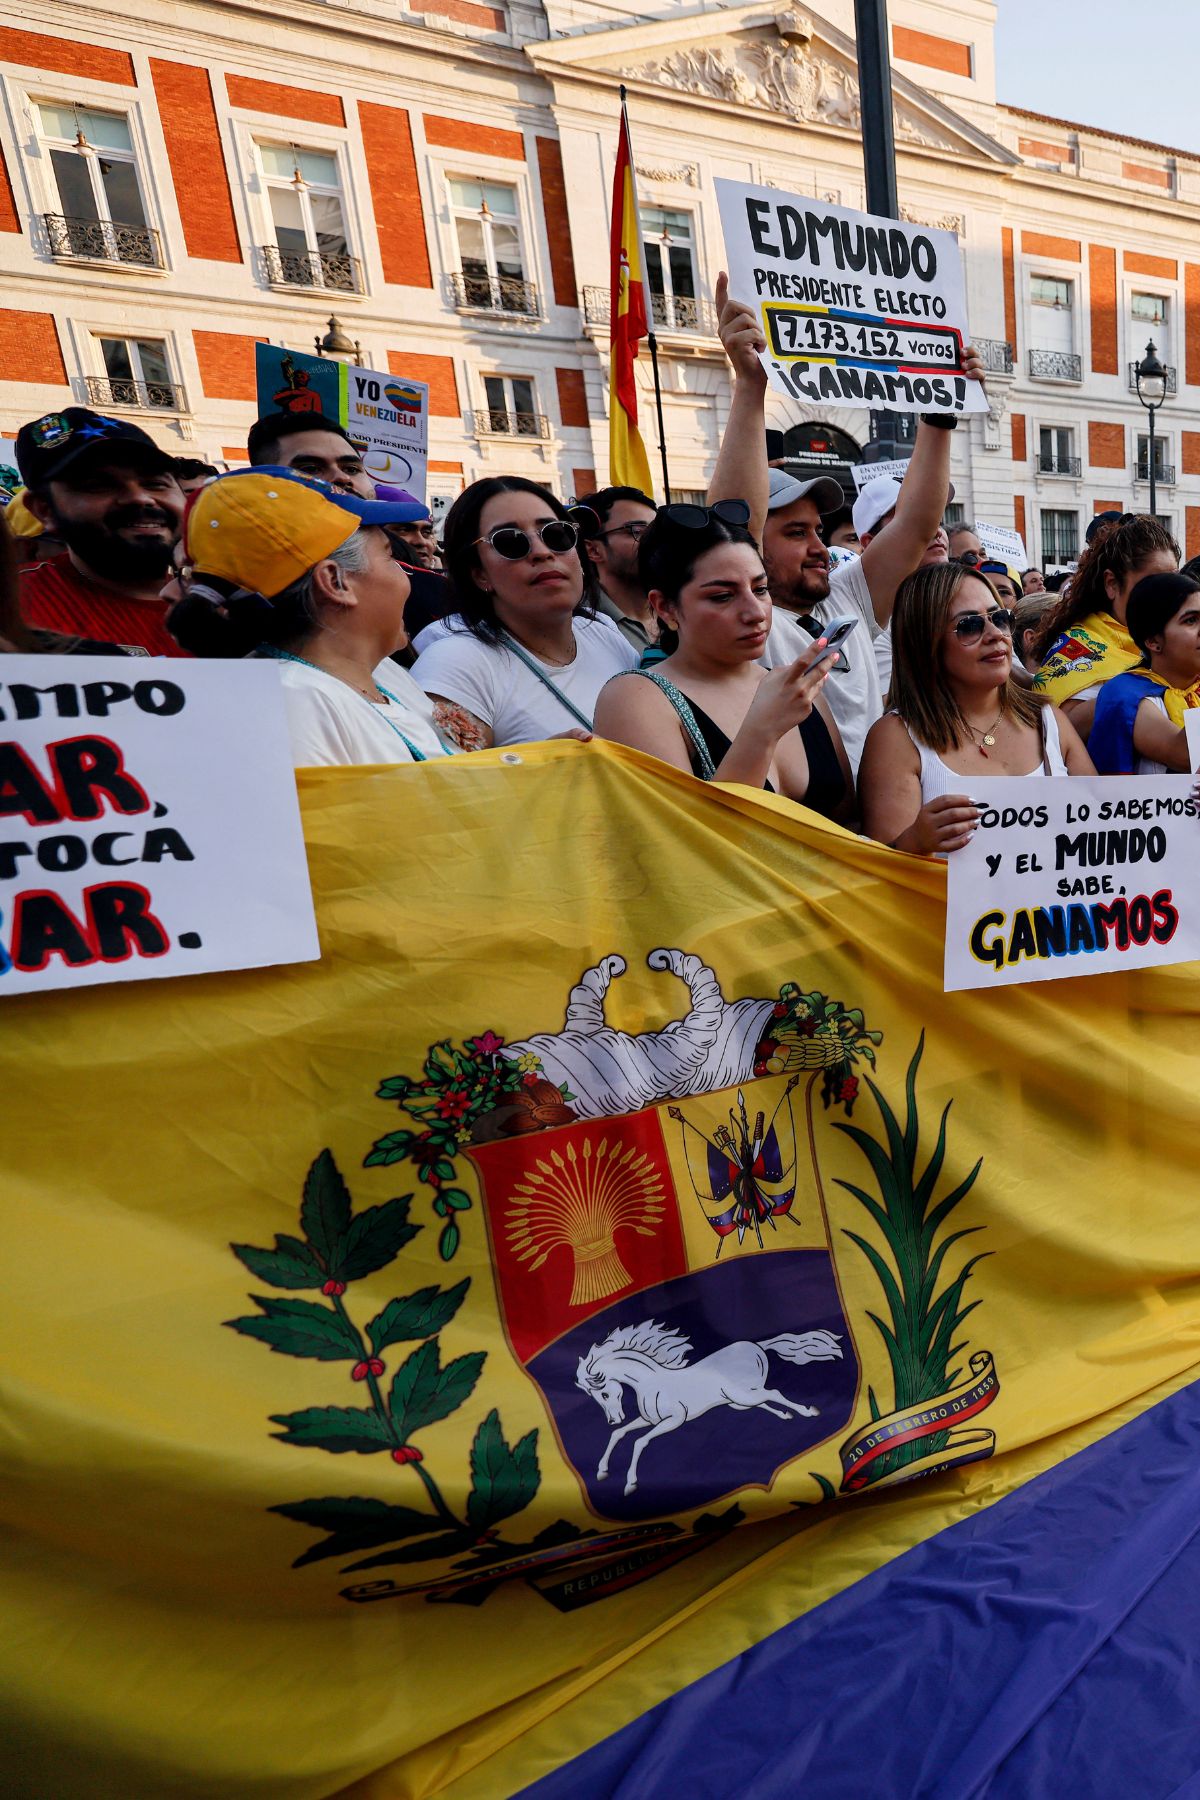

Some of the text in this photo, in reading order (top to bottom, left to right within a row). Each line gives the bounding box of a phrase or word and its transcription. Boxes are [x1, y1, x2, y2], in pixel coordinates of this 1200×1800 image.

[745, 197, 937, 282] EDMUNDO
[753, 268, 947, 319] PRESIDENTE ELECTO
[777, 315, 954, 360] 7.173.152 VOTOS
[354, 376, 381, 402] YO
[771, 361, 967, 411] ¡GANAMOS!
[355, 402, 417, 429] VENEZUELA
[860, 466, 871, 474] EN
[981, 542, 1021, 557] ASISTIDO
[1066, 803, 1090, 824] LO
[985, 825, 1167, 877] Y EL MUNDO
[0, 880, 203, 977] AR.
[969, 888, 1180, 972] GANAMOS
[849, 1376, 995, 1463] 20 DE FEBRERO DE 1859
